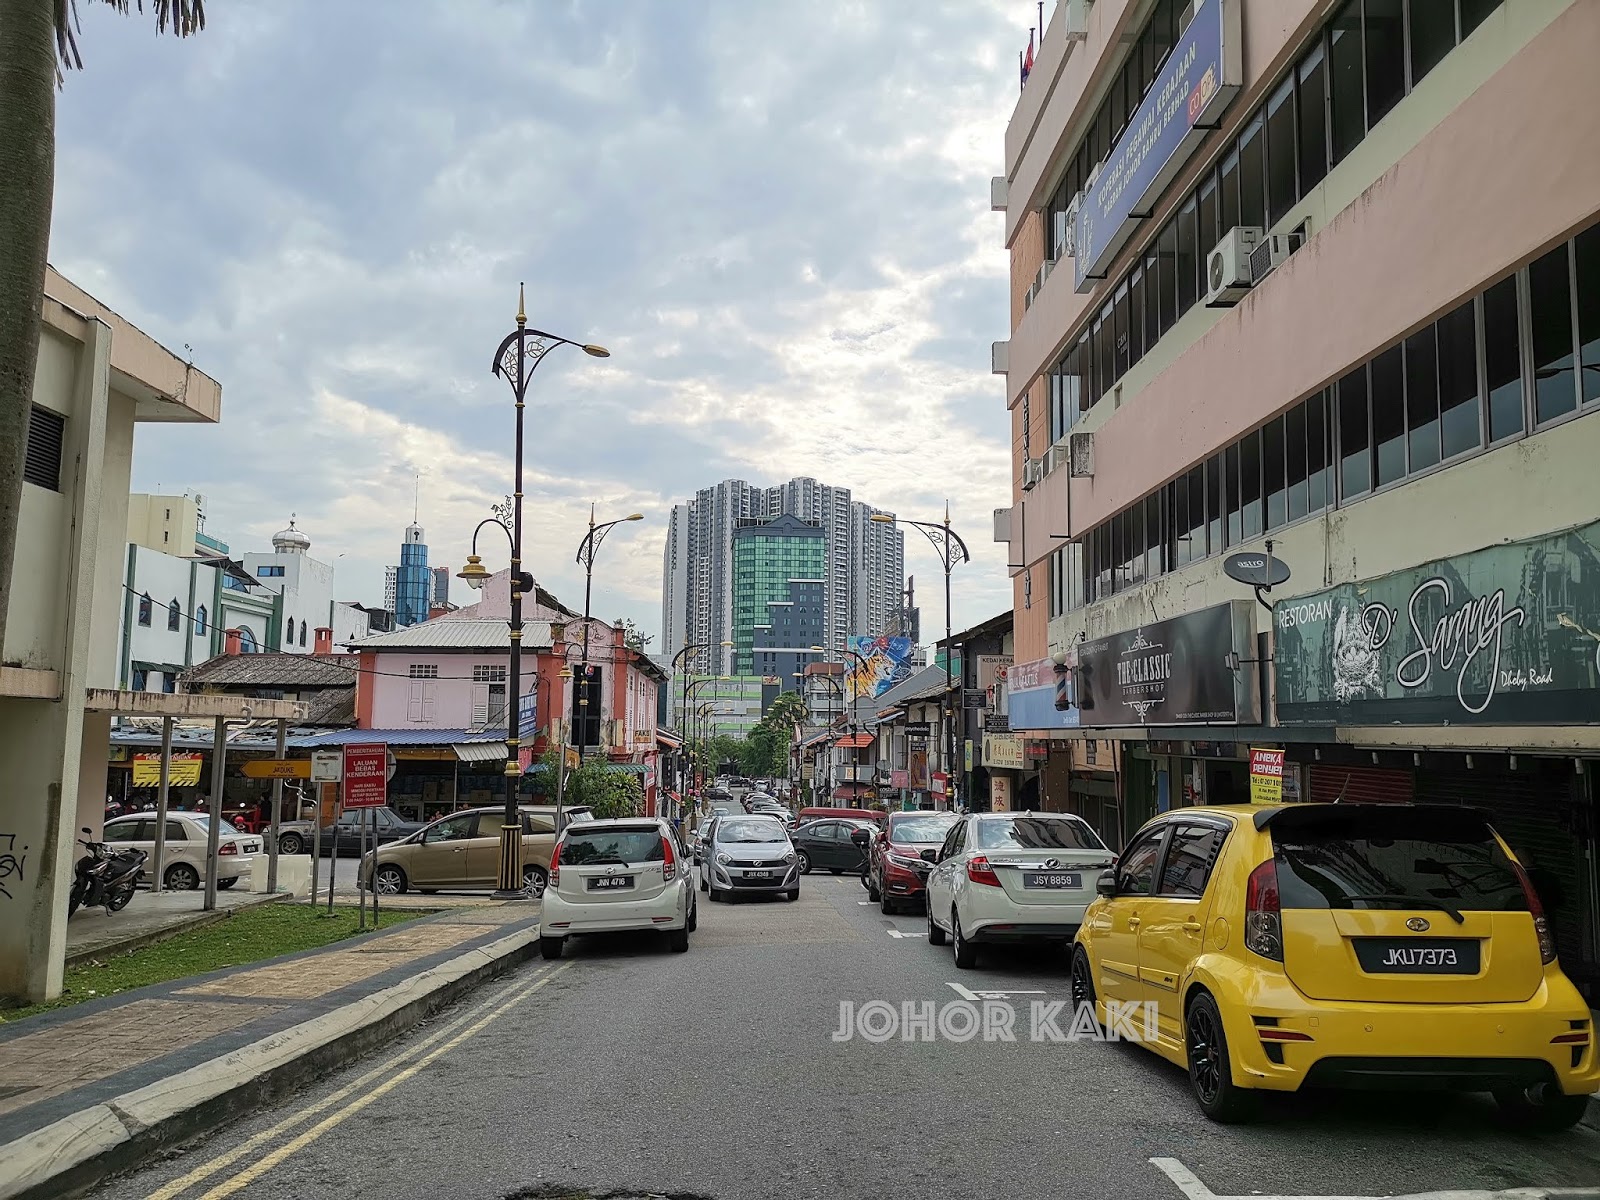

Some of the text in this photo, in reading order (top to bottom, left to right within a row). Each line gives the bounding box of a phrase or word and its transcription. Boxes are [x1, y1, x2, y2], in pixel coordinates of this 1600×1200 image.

[1097, 41, 1196, 208] KOPERASI PEGAWAI KERAJAAN
[1103, 80, 1189, 219] DAERAH JOHOR BAHRU BERHAD
[1237, 560, 1265, 568] astro
[1279, 600, 1333, 629] RESTORAN
[1362, 577, 1525, 714] D' Sarang
[1117, 653, 1171, 685] THE CLASSIC
[1500, 667, 1553, 692] Dhoby Road
[1122, 684, 1165, 696] BARBERSHOP
[596, 878, 625, 886] JNN 4716
[1033, 876, 1072, 885] JSY 8859
[1383, 949, 1457, 965] JKU7373
